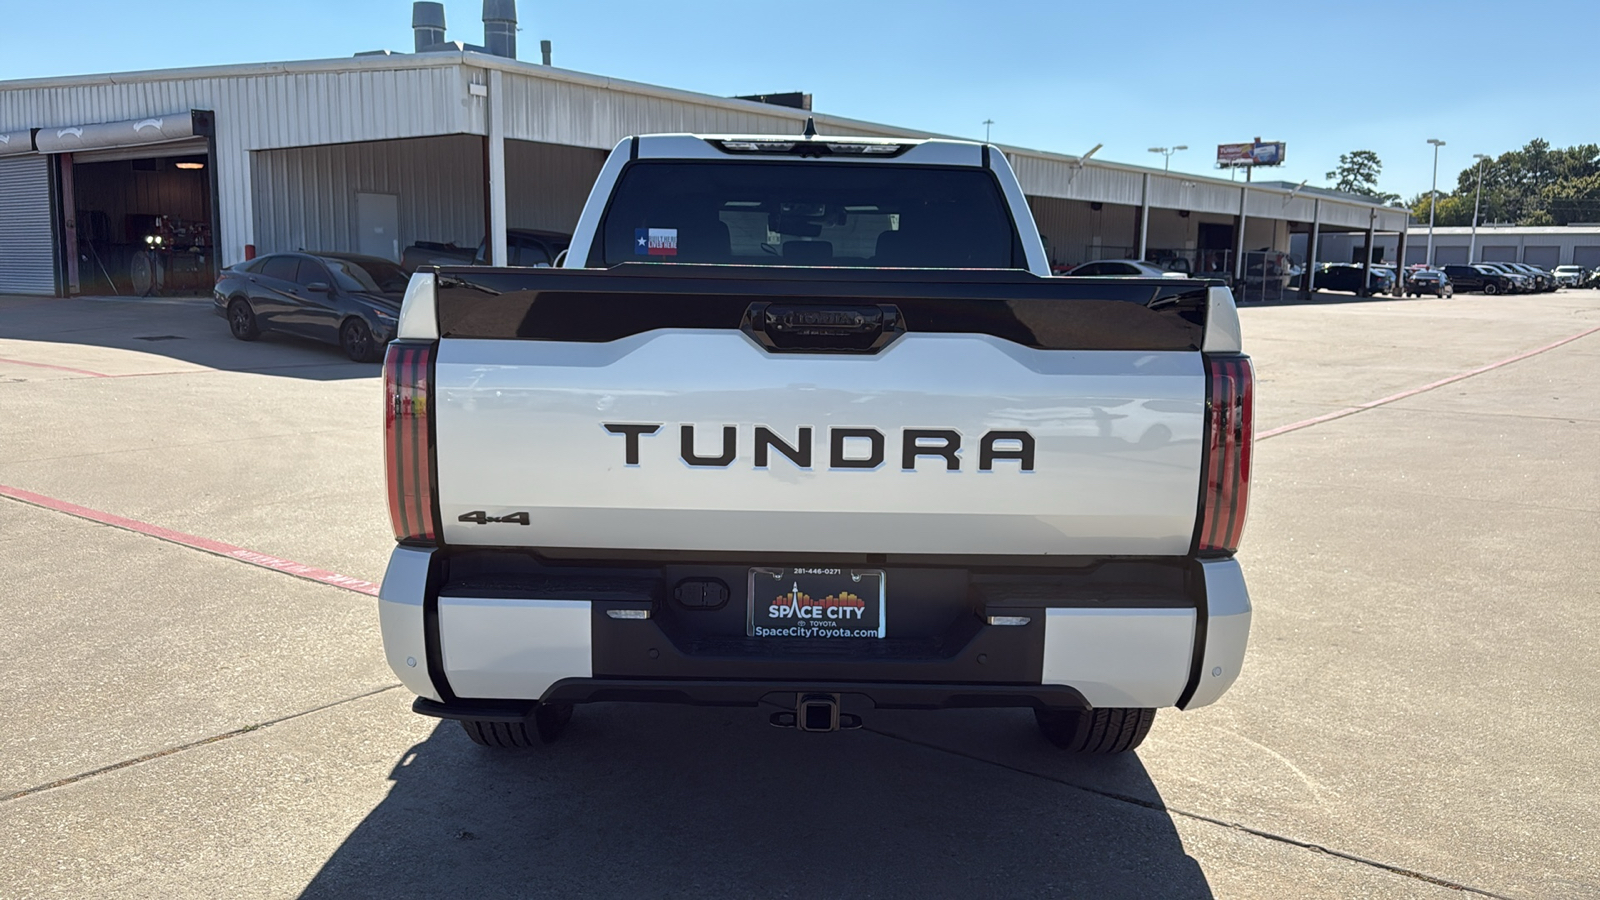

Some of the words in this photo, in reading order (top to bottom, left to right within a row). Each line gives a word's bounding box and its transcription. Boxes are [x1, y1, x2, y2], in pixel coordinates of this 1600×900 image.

[601, 422, 1037, 473] TUNDRA
[768, 605, 823, 618] SPACE
[826, 606, 866, 619] CITY
[755, 626, 878, 638] SpaceCityToyota.com
